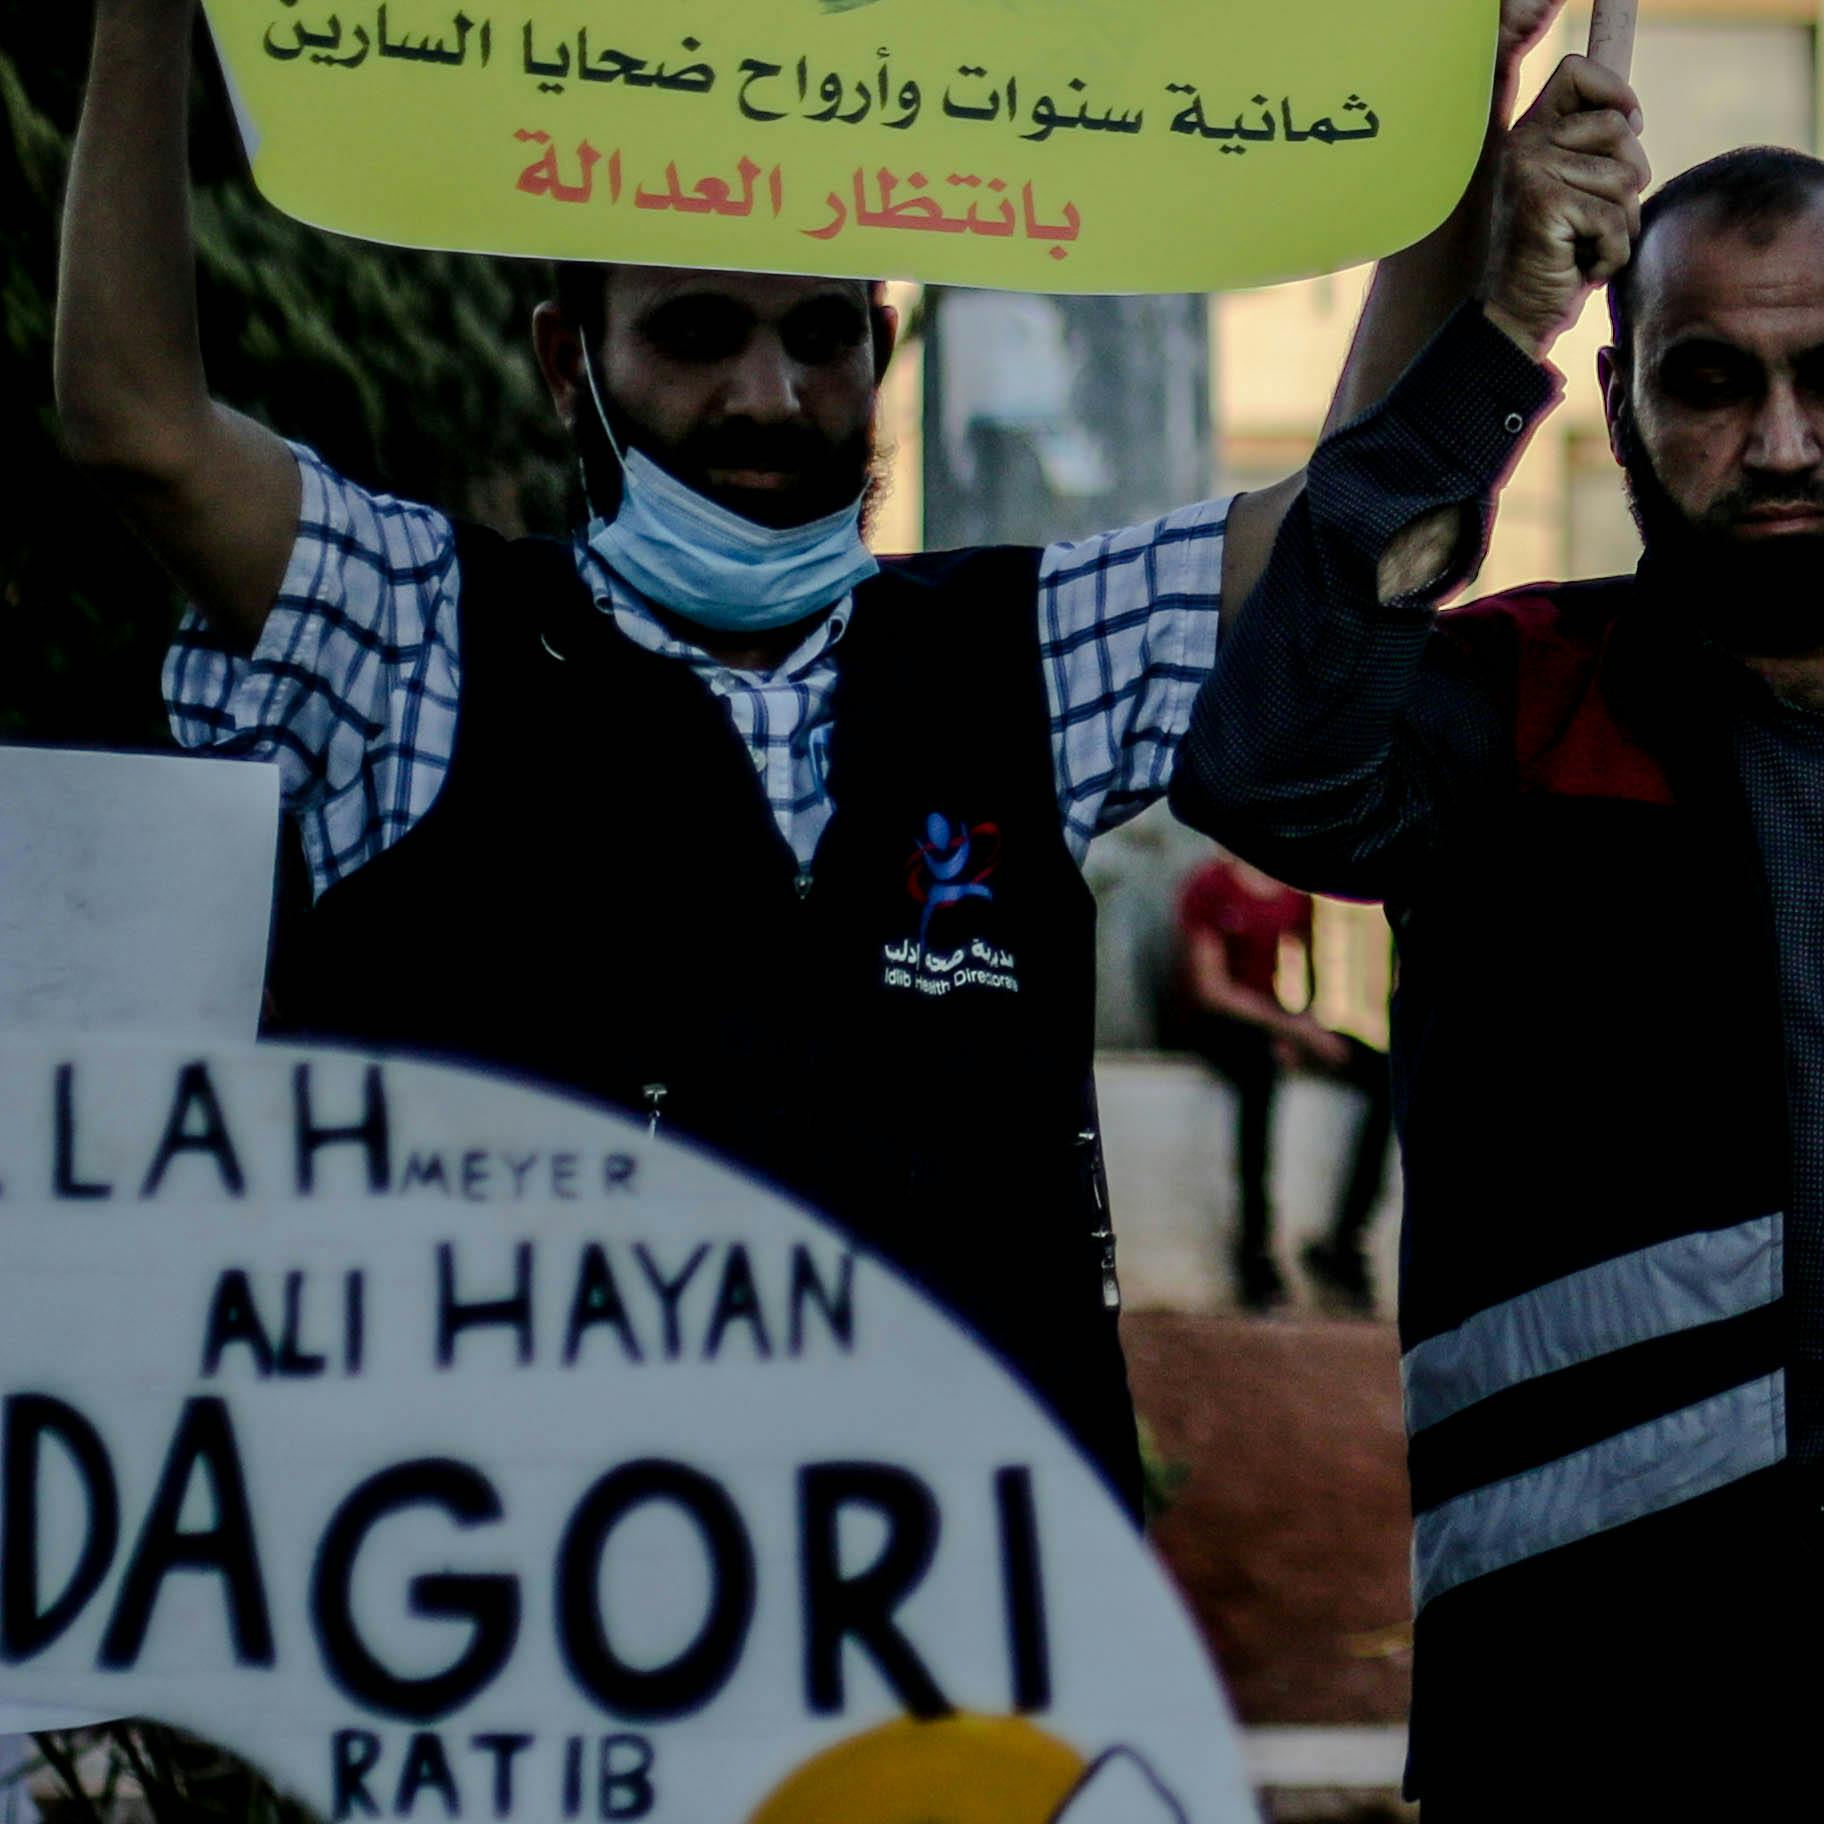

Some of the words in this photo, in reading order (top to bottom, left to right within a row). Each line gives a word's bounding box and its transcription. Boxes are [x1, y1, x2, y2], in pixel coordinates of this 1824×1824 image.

[521, 18, 717, 96] ضحايا
[736, 45, 922, 131] وأرواح
[941, 64, 1144, 143] سنوات
[1163, 82, 1381, 156] ثمانية
[515, 129, 783, 217] العدالة
[802, 168, 1081, 260] بانتظار
[0, 1061, 392, 1200] LAH
[402, 1149, 638, 1201] MEYER
[202, 1268, 366, 1378] ALI
[435, 1235, 860, 1368] HAYAN
[325, 1728, 657, 1822] RATIB
